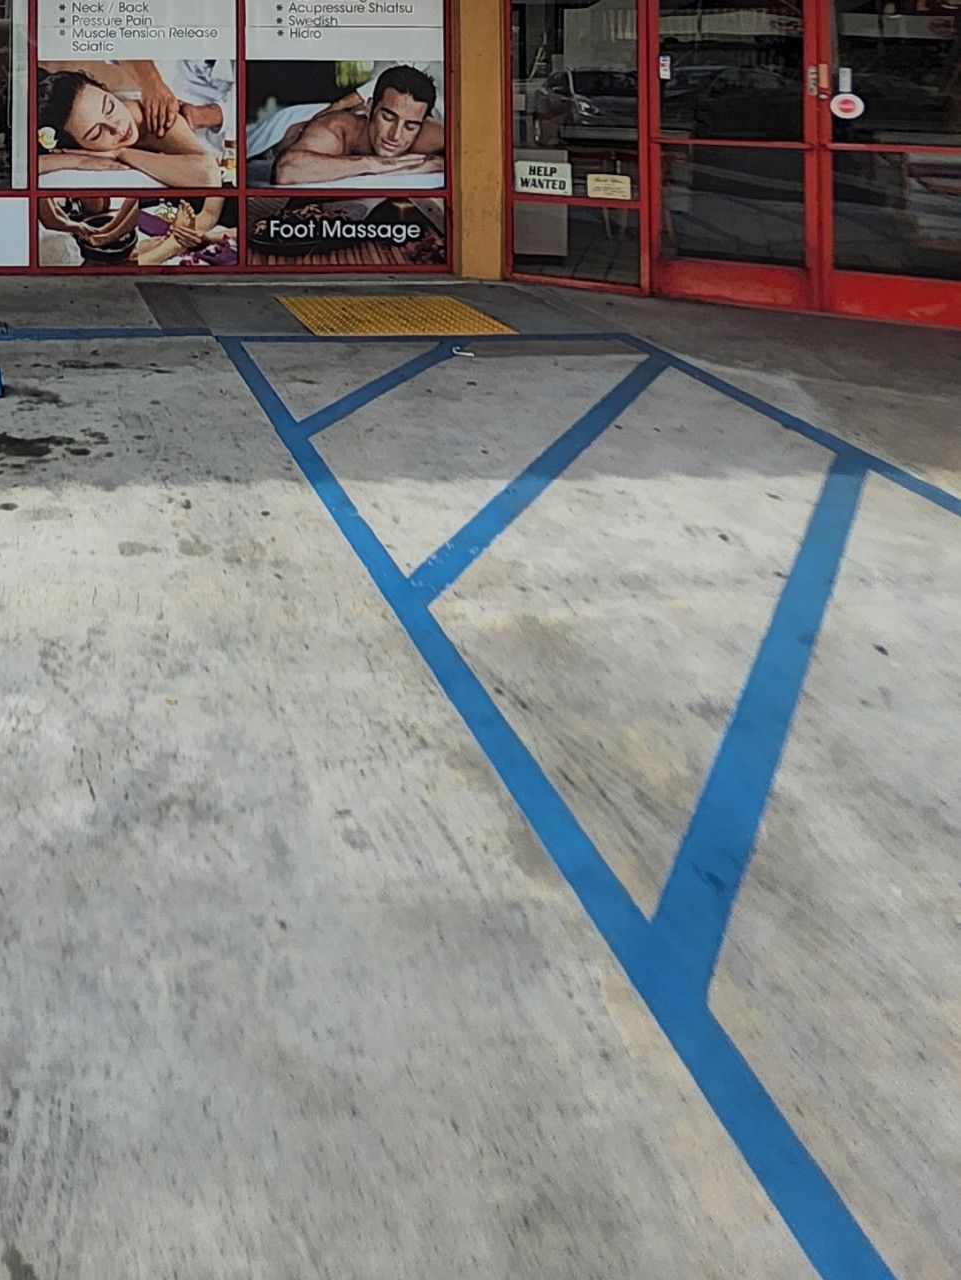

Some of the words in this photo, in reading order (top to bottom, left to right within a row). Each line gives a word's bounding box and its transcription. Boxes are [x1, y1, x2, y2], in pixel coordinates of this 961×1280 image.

[72, 1, 104, 13] Neck
[118, 1, 149, 13] Back
[288, 2, 365, 15] Acupressure
[369, 2, 413, 13] Shiatsu
[72, 15, 123, 26] Pressure
[126, 15, 153, 26] Pain
[288, 15, 338, 27] Swedish
[72, 27, 117, 39] Muscle
[120, 27, 166, 39] Tension
[169, 27, 218, 39] Release
[289, 28, 322, 39] Hidro
[72, 40, 115, 52] Sciatic
[528, 165, 557, 177] HELP
[520, 177, 566, 191] WANTED
[270, 220, 316, 239] Foot
[322, 220, 421, 244] Massage
